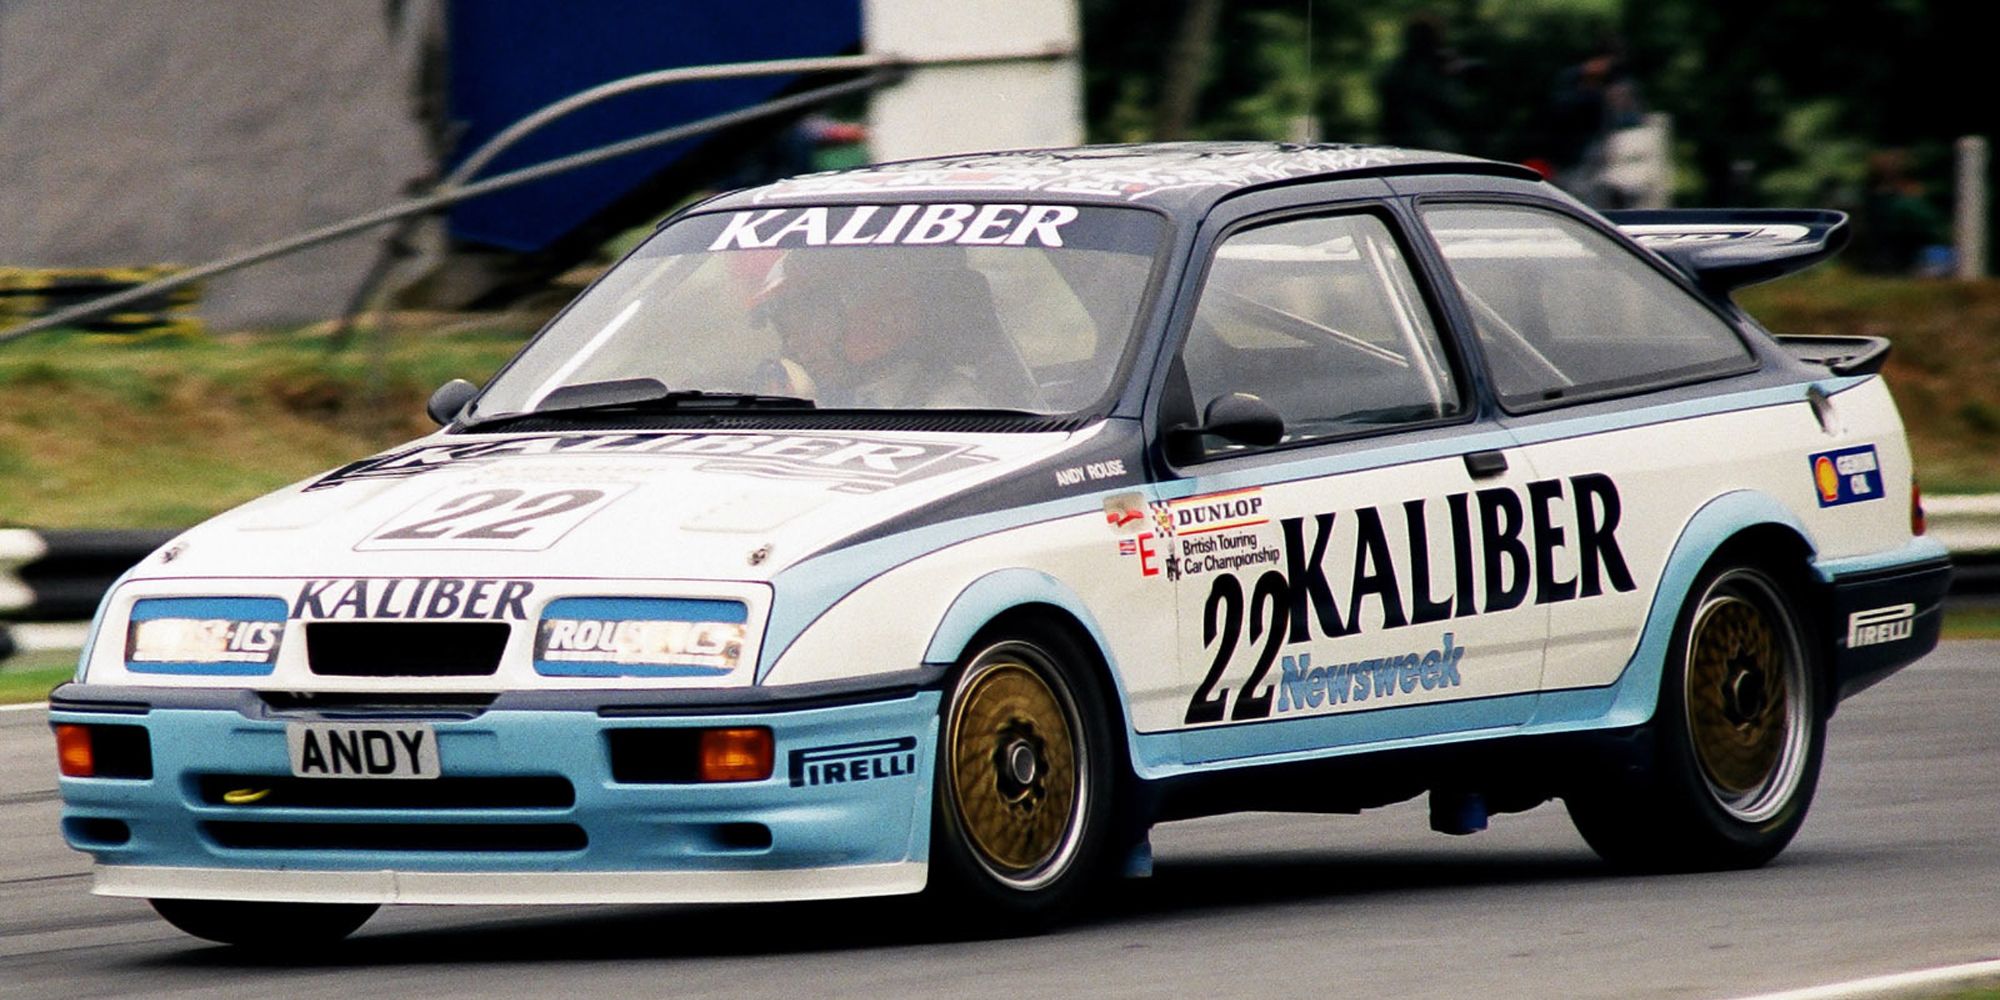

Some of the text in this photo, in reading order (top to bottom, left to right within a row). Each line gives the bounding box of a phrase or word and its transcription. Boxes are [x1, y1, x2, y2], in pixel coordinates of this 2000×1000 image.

[708, 203, 1079, 251] KALIBER
[1055, 459, 1127, 487] ANDY ROUSE
[373, 488, 606, 540] 22
[1177, 497, 1263, 526] DUNLOP
[1138, 532, 1160, 577] E
[1182, 531, 1257, 556] British Touring
[1184, 544, 1280, 575] Car Championship
[1279, 472, 1638, 645] KALIBER
[289, 579, 535, 621] KALIBER
[1184, 571, 1292, 725] 22
[1847, 603, 1916, 648] PIRELLI
[1278, 633, 1464, 712] Newsweek
[301, 729, 425, 775] ANDY
[788, 736, 917, 788] PIRELLI
